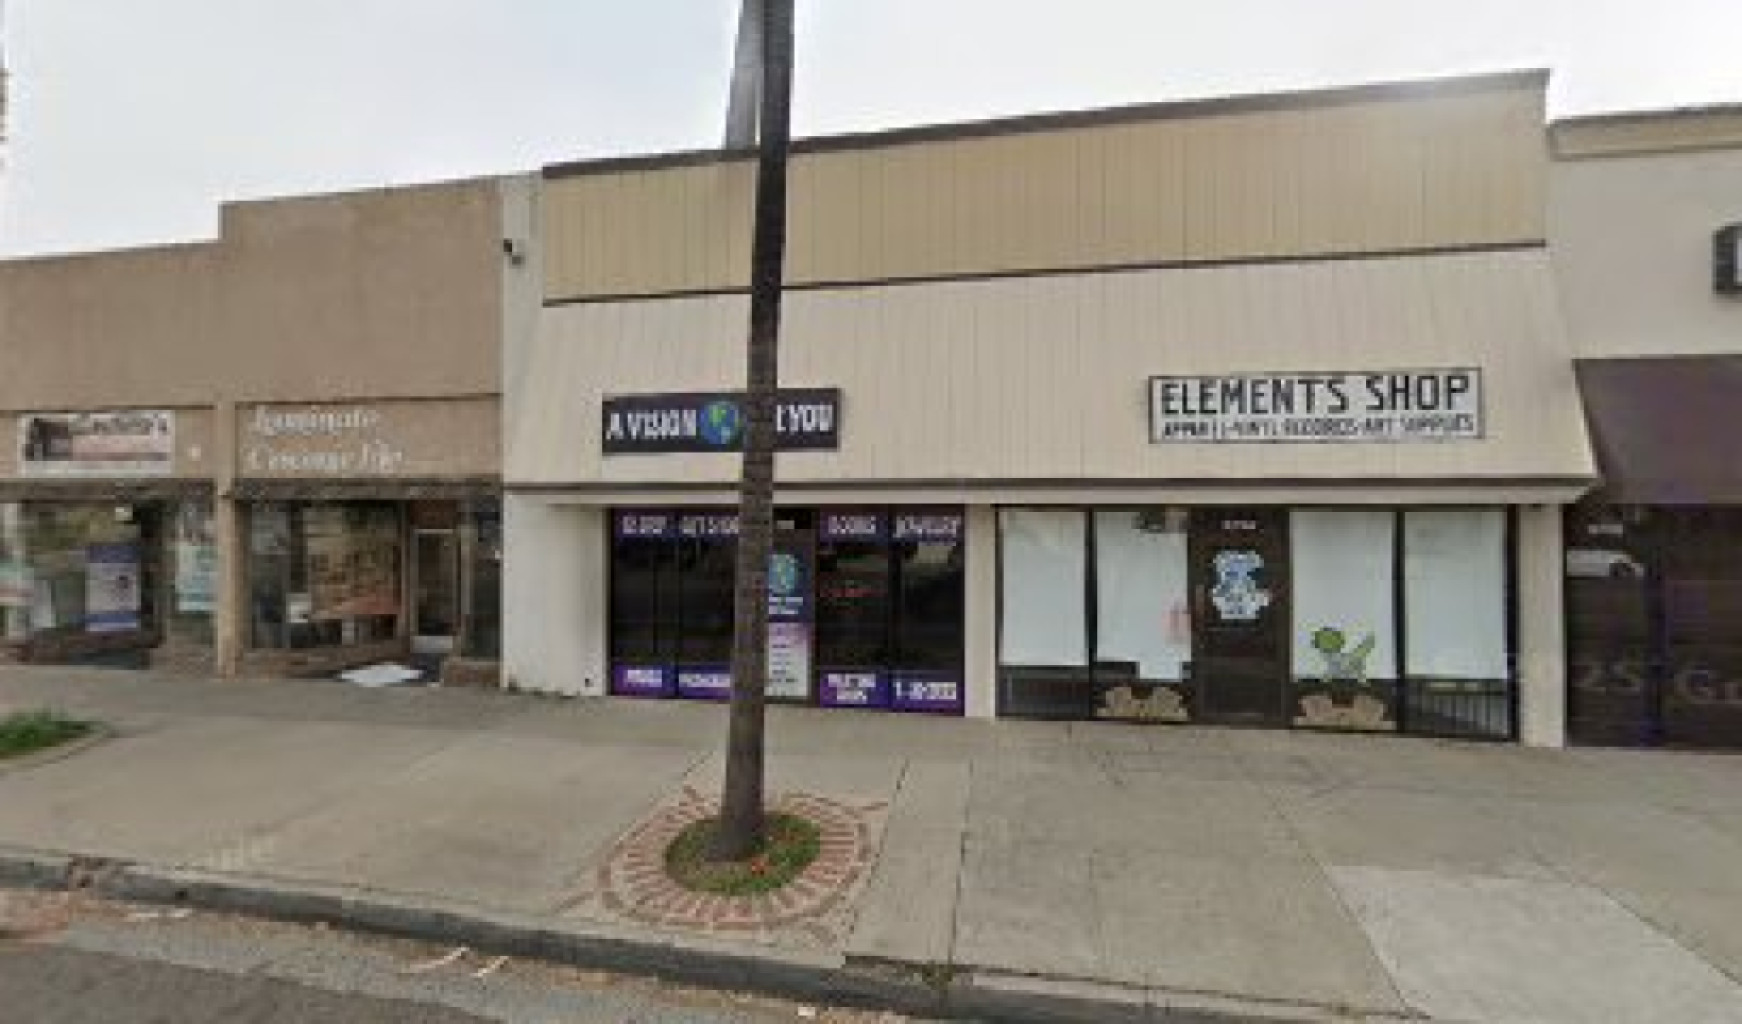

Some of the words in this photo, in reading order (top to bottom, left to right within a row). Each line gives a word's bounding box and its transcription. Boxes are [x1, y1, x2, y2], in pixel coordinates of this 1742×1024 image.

[1161, 379, 1349, 415] ELEMENTS
[1366, 375, 1469, 411] SHOP
[606, 412, 624, 440] A
[626, 409, 697, 440] VISION
[788, 404, 834, 432] YOU
